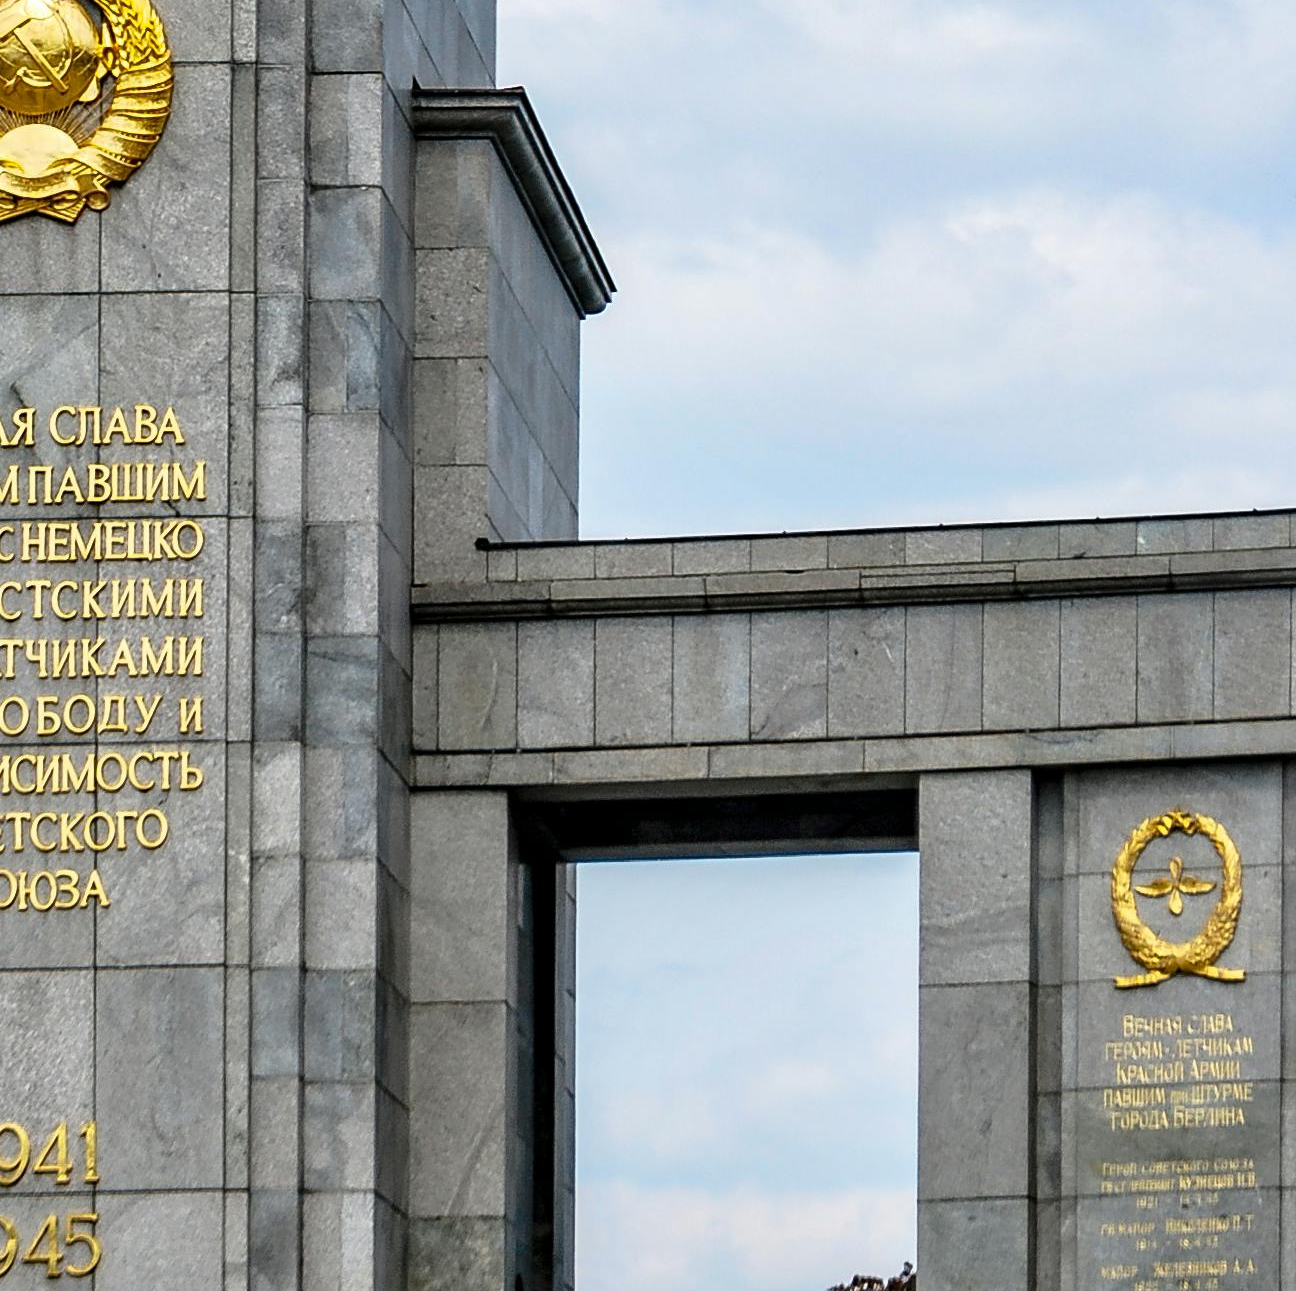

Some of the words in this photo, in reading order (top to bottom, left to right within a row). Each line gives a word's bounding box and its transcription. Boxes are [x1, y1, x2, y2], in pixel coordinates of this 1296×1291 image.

[49, 404, 185, 446] СЛАВА
[27, 460, 206, 504] ПАВШИМ
[21, 520, 204, 563] НЕМЕЦКО
[179, 698, 204, 733] И
